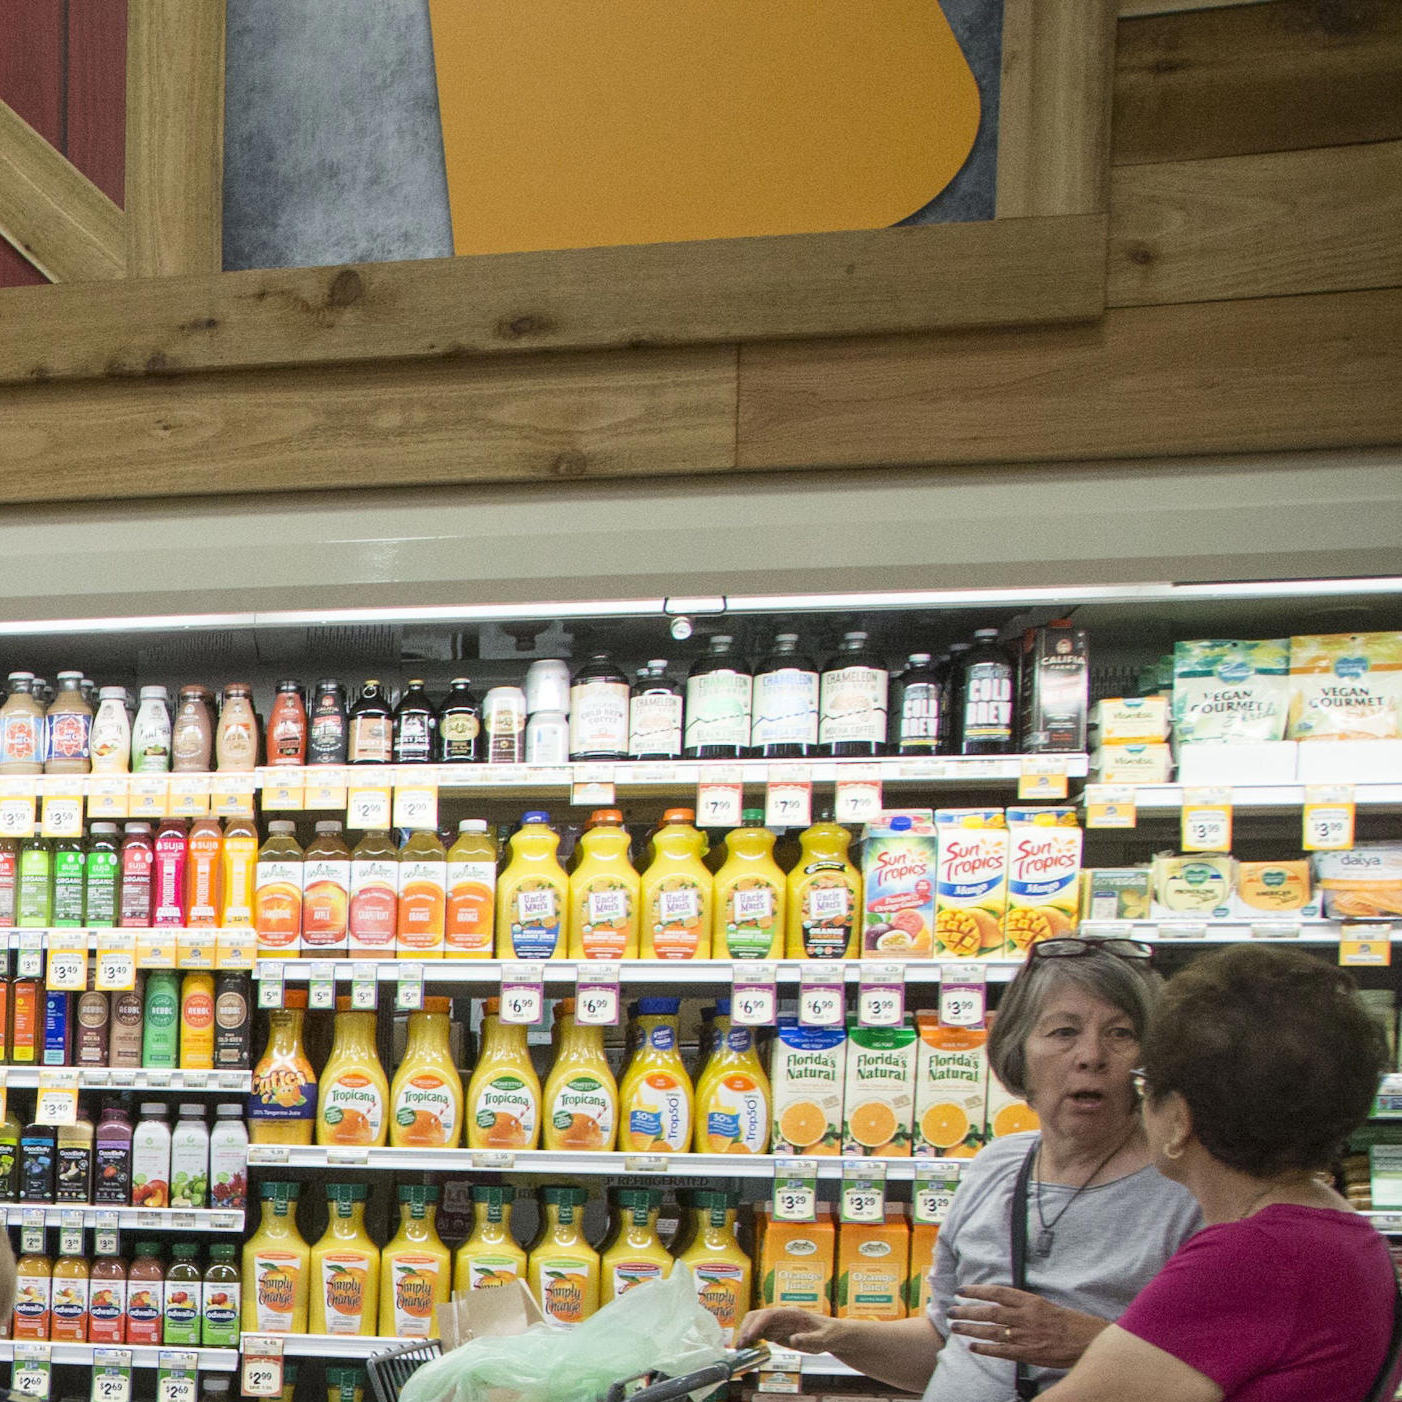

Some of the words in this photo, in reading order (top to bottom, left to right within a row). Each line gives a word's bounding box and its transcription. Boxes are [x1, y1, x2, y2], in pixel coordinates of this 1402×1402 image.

[827, 672, 877, 683] CHAMELEON
[1321, 687, 1369, 696] VEGAN
[879, 847, 906, 867] Sun
[946, 841, 980, 864] Sun
[1017, 839, 1052, 861] Sun
[946, 853, 1004, 881] Tropics
[1017, 849, 1076, 878] Tropics
[1341, 854, 1381, 867] daiya
[878, 857, 927, 886] Tropics
[787, 1053, 836, 1069] Florida's
[857, 1053, 908, 1069] Florida's
[929, 1053, 979, 1069] Florida's
[787, 1065, 836, 1082] Natural
[857, 1066, 908, 1081] Natural
[929, 1066, 979, 1082] Natural
[332, 1091, 375, 1104] Tropicana
[404, 1091, 448, 1105] Tropicana
[484, 1093, 529, 1107] Tropicana
[561, 1093, 606, 1107] Tropicana
[635, 1112, 655, 1123] 50%
[714, 1114, 733, 1125] 50%
[746, 1099, 757, 1142] Trop50
[778, 1270, 824, 1285] Orange
[852, 1272, 897, 1285] Orange
[258, 1277, 293, 1298] Simply
[327, 1278, 362, 1300] Simply
[396, 1280, 432, 1302] Simply
[785, 1280, 814, 1293] Juice
[859, 1282, 888, 1294] Juice
[545, 1285, 581, 1304] Simply
[698, 1288, 735, 1310] Simply
[15, 1304, 45, 1313] odwalla
[54, 1305, 83, 1315] odwalla
[91, 1306, 120, 1316] odwalla
[129, 1308, 158, 1318] odwalla
[167, 1309, 196, 1320] odwalla
